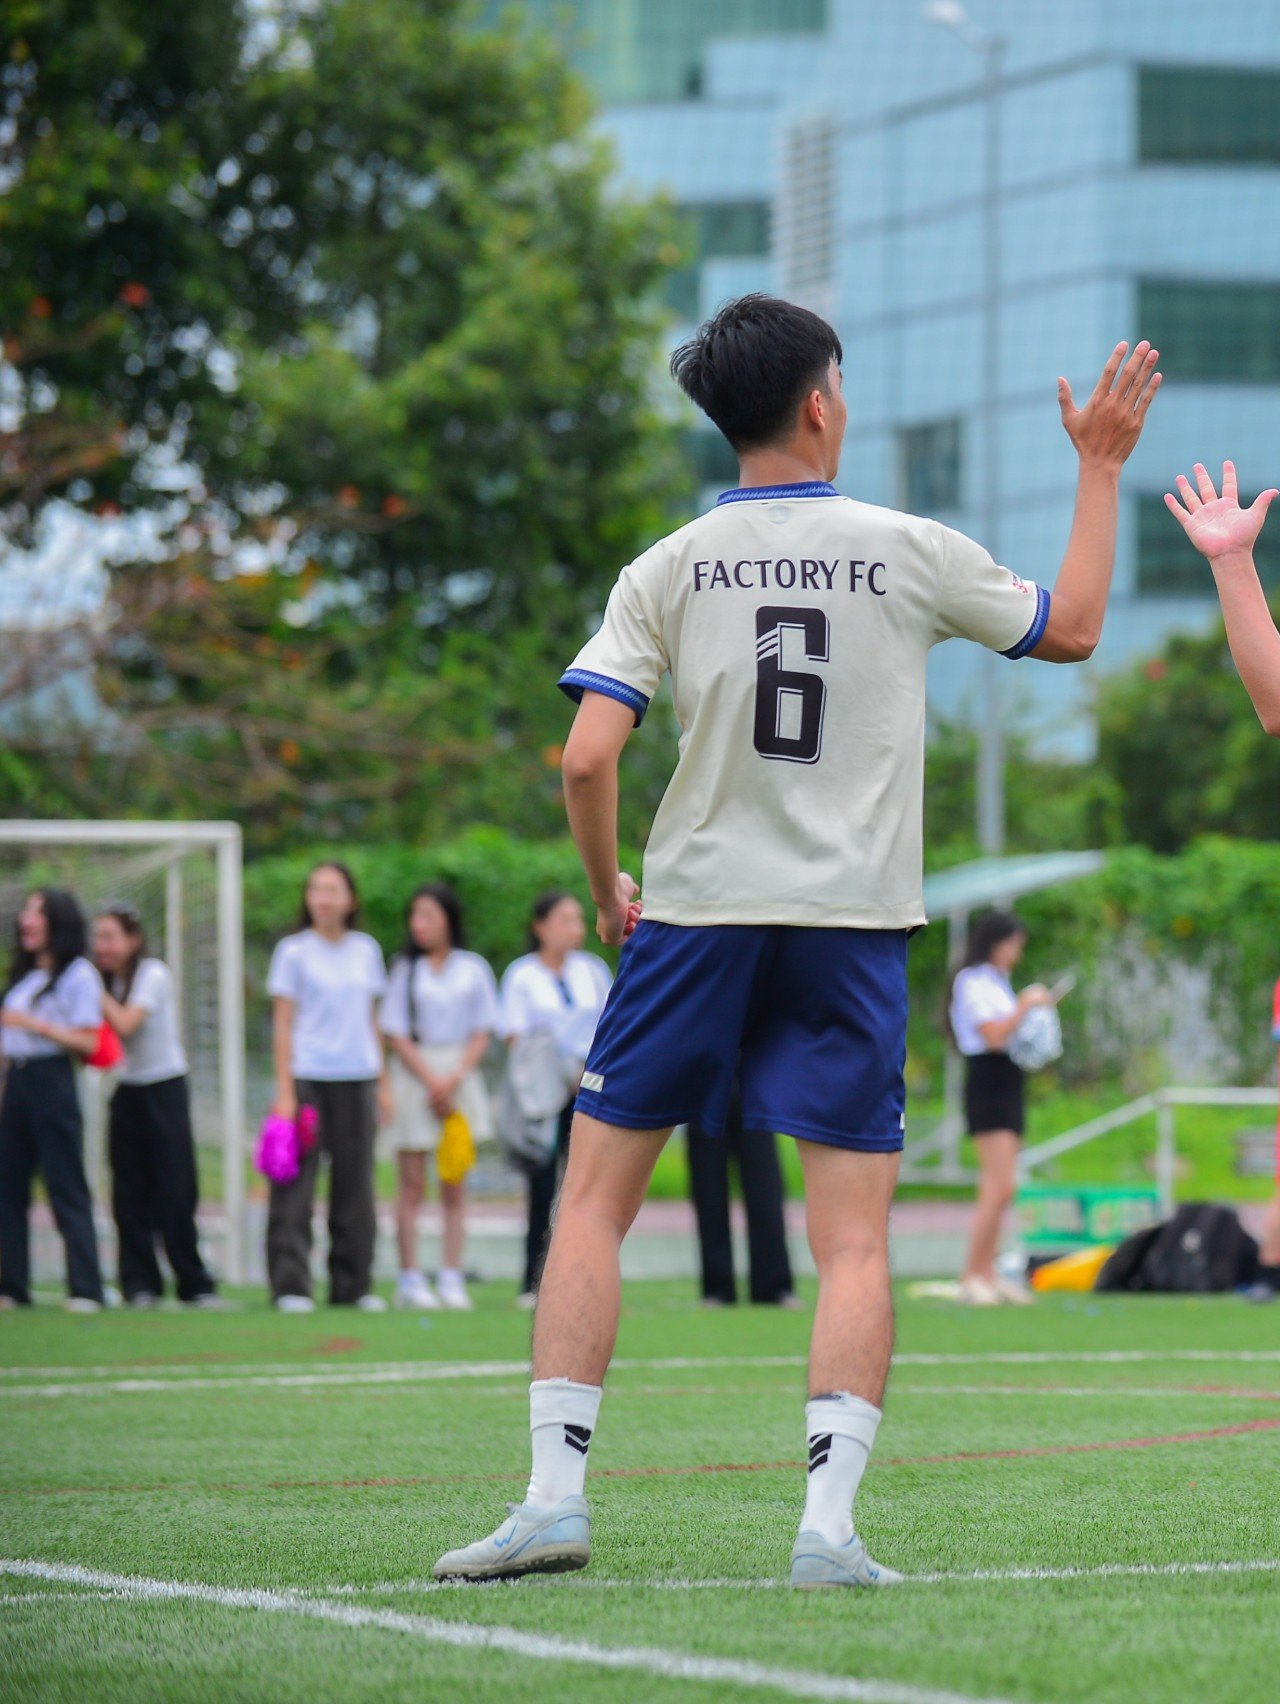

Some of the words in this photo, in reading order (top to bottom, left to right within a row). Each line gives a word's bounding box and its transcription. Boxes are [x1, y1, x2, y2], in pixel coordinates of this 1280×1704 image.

[693, 558, 840, 592] FACTORY
[849, 560, 887, 596] FC
[753, 605, 830, 765] 6
